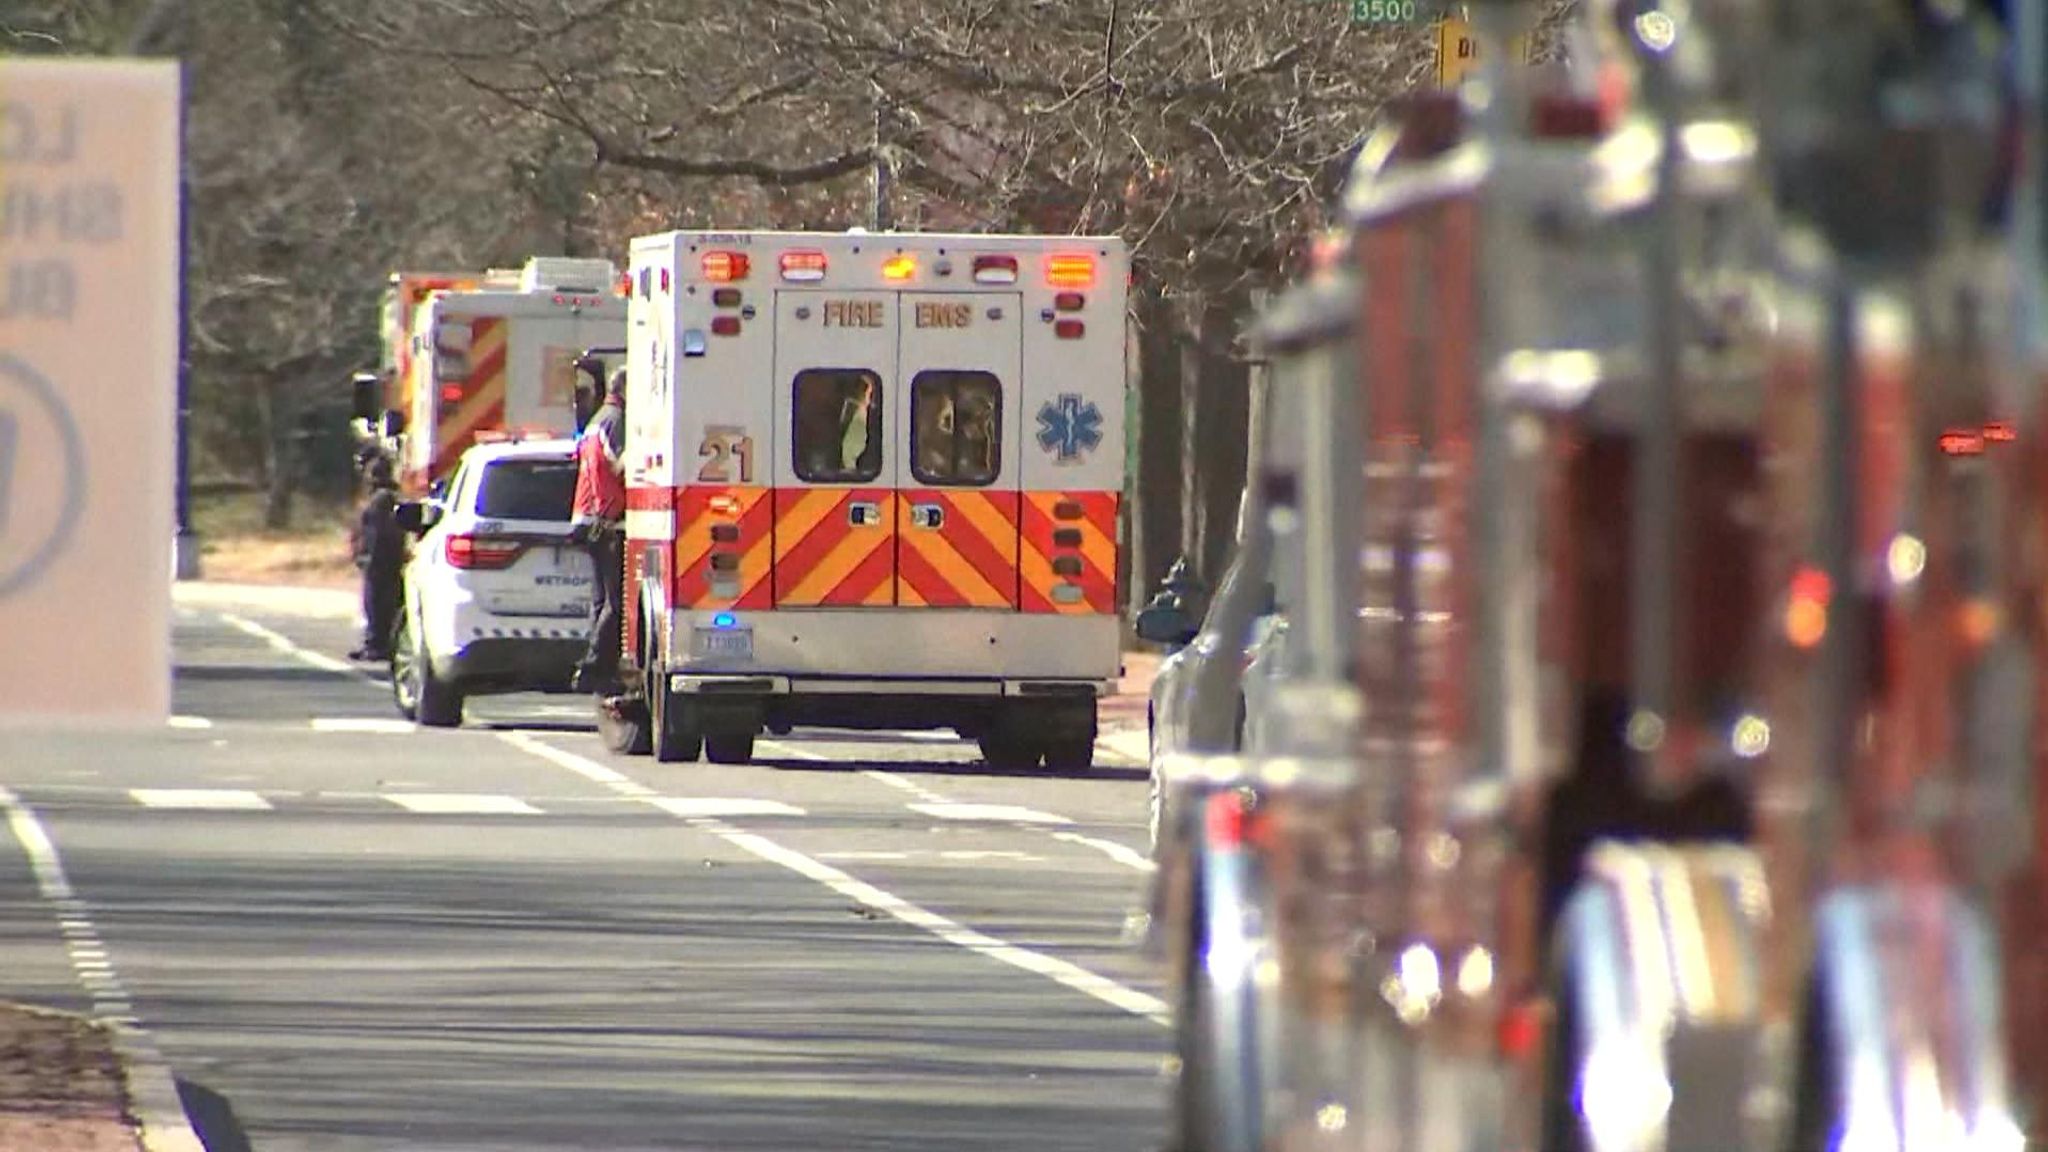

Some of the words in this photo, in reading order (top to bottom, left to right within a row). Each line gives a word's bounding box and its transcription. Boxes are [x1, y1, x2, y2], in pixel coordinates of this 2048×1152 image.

[1356, 0, 1415, 20] 3500
[823, 301, 884, 328] FIRE
[915, 302, 971, 329] EMS
[698, 426, 753, 482] 21
